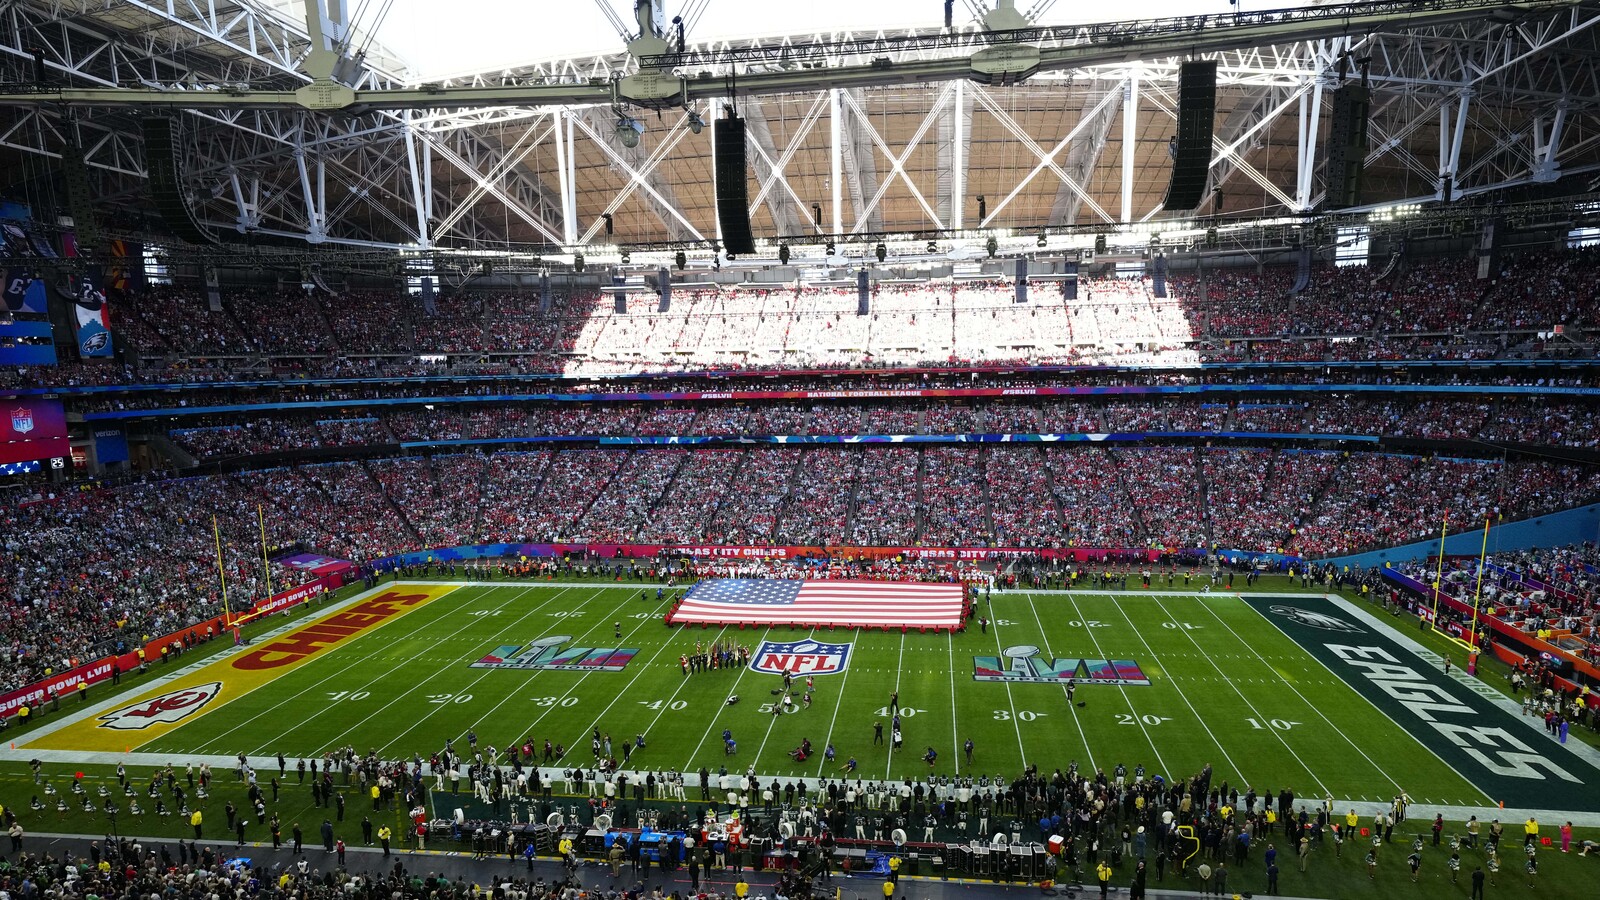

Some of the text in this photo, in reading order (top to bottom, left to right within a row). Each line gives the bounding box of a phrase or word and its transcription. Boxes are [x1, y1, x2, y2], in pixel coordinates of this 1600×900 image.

[13, 418, 33, 429] NFL
[95, 429, 120, 438] verizon
[52, 459, 63, 468] 25
[743, 548, 786, 557] CHIEFS
[287, 591, 308, 604] BOWL
[231, 592, 430, 671] CHIEFS
[760, 654, 836, 673] NFL
[0, 663, 112, 713] SUPER BOWL LVII
[328, 690, 371, 701] 10
[428, 693, 474, 704] 20
[122, 691, 208, 718] KC
[536, 696, 579, 708] 30
[646, 699, 688, 711] 40
[757, 703, 800, 714] 50
[873, 706, 916, 718] 40
[1323, 643, 1585, 784] EAGLES
[993, 709, 1037, 721] 30
[1114, 713, 1162, 726] 20
[1244, 717, 1292, 730] 10
